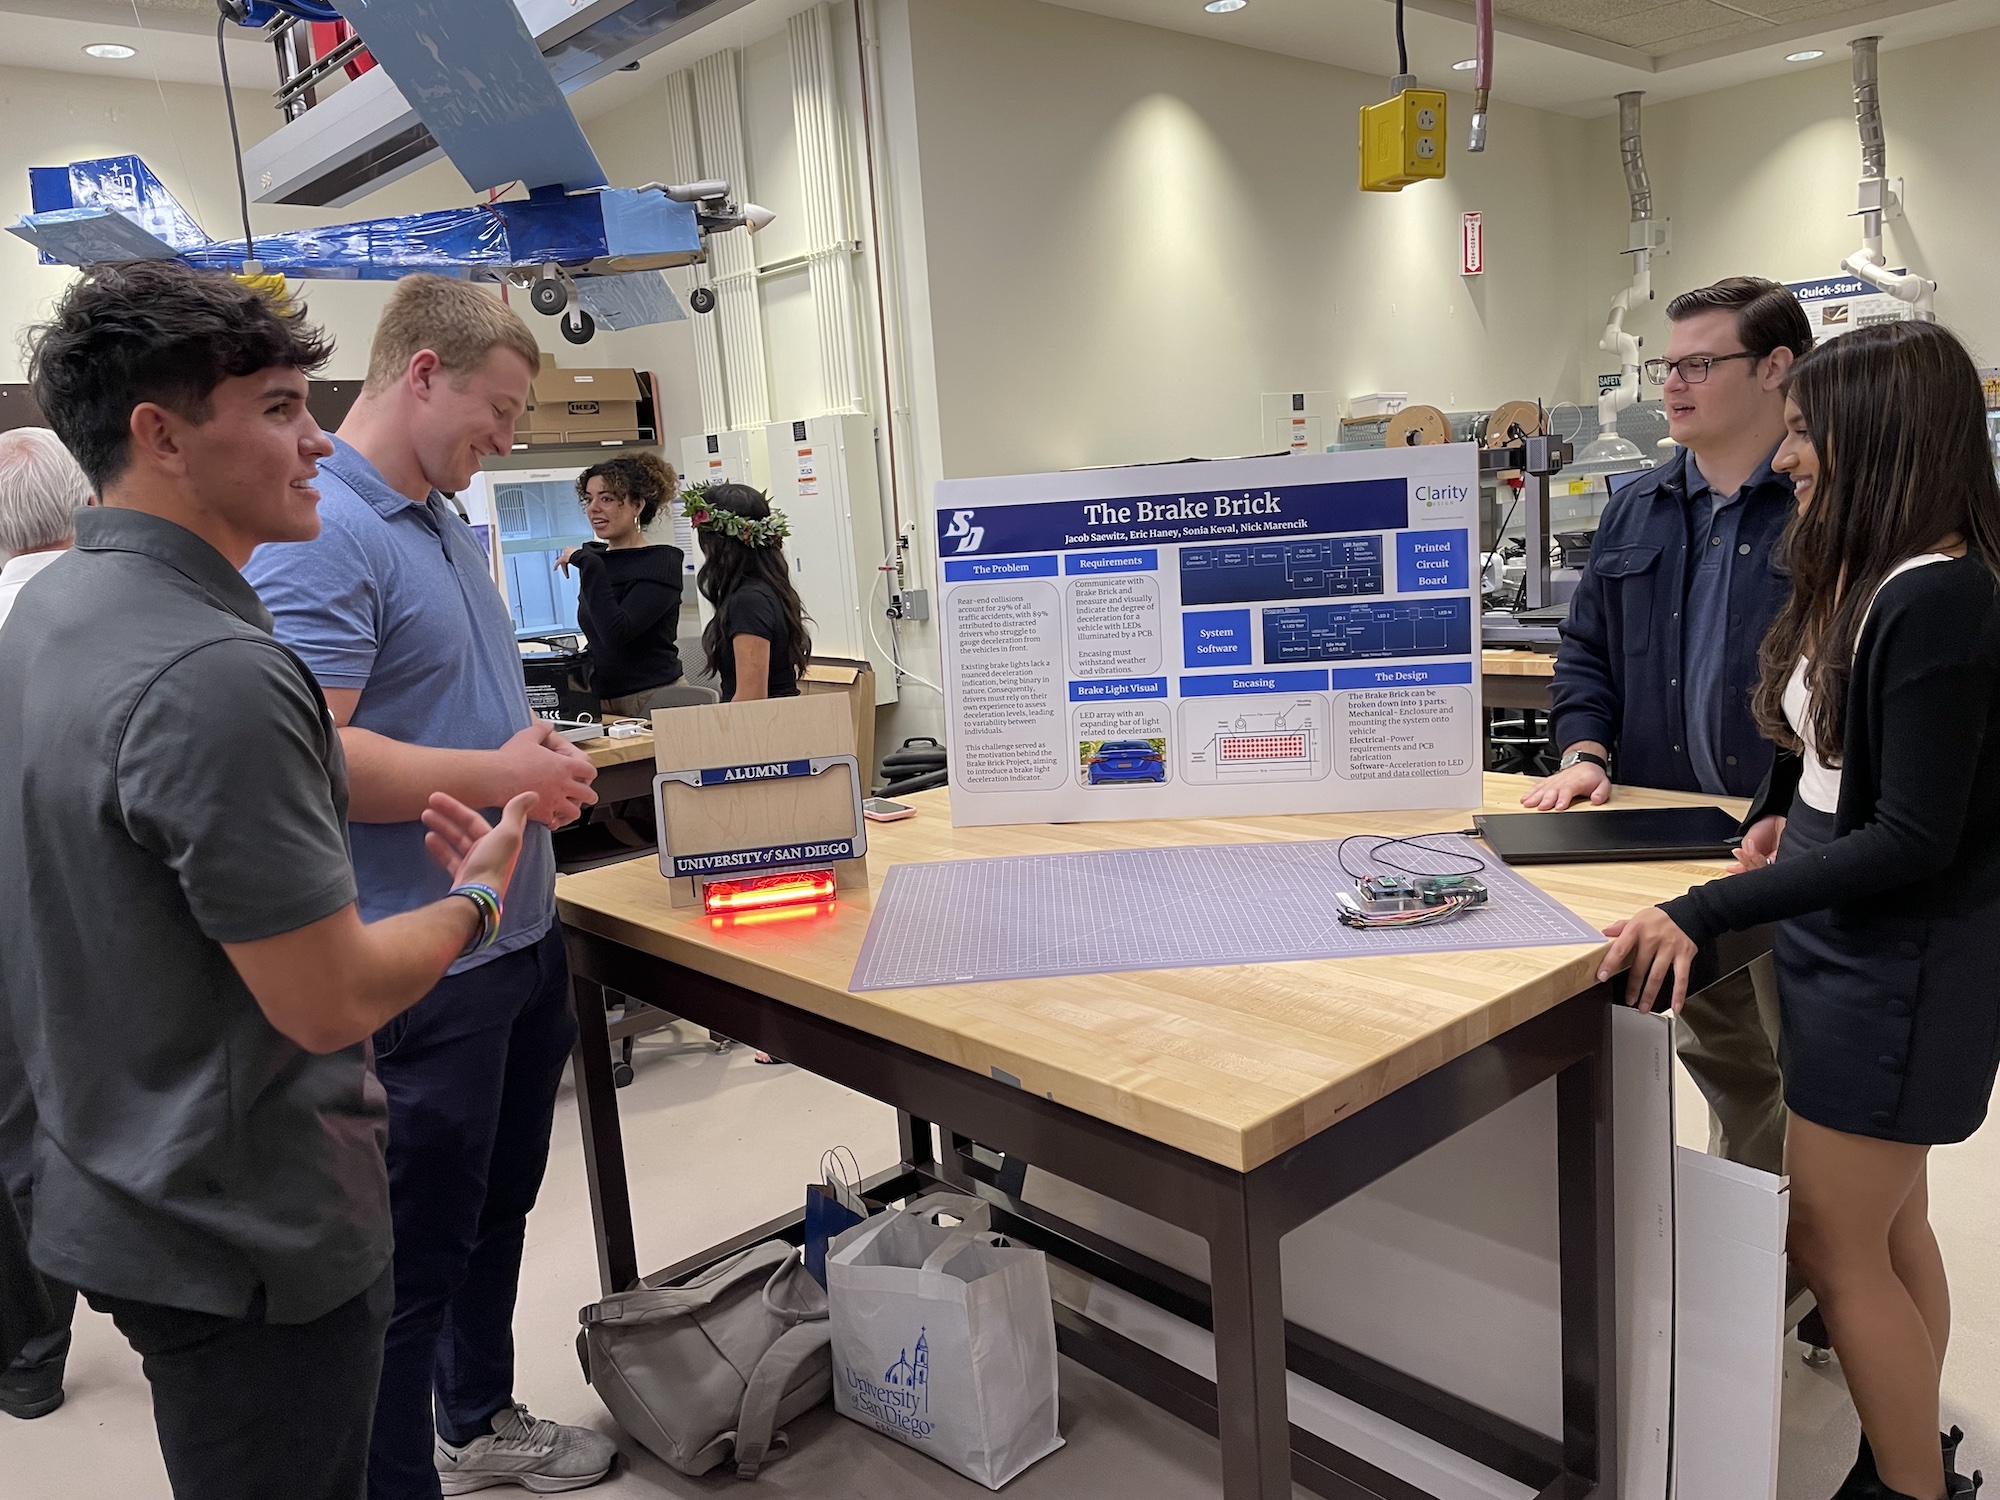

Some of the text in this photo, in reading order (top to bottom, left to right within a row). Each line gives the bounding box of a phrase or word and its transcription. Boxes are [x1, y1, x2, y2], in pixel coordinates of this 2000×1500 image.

[1800, 281, 1862, 299] Quick-Start
[1416, 485, 1468, 503] Clarity
[1084, 492, 1281, 525] The Brake Brick
[1064, 519, 1307, 544] Jacob Saewitz, Eric Haney, Sonia Keval, Nick Marencik
[1414, 542, 1450, 552] Printed
[973, 563, 1029, 574] The Problem
[1080, 557, 1142, 569] Requirements
[1416, 559, 1449, 569] Circuit
[1074, 576, 1144, 588] Communicate with
[1419, 575, 1447, 585] Board
[1075, 586, 1132, 596] Brake Brick and
[957, 594, 1023, 605] Rear-end collisions
[1108, 595, 1122, 603] and
[1123, 594, 1152, 603] visually
[957, 605, 984, 613] account
[985, 604, 995, 612] for
[997, 604, 1013, 612] 29%
[1013, 602, 1021, 610] of
[1076, 602, 1154, 614] indicate the degree of
[957, 609, 1048, 621] traffic accidents, with 89%
[1076, 613, 1121, 623] deceleration
[1123, 612, 1133, 620] for
[958, 618, 1036, 630] attributed to distracted
[1076, 621, 1141, 631] vehicle with LEDs
[958, 630, 983, 638] drivers
[999, 627, 1028, 636] struggle
[1077, 631, 1120, 640] illuminated
[1120, 630, 1130, 640] by
[1137, 629, 1153, 637] PCB.
[1200, 629, 1233, 639] System
[959, 635, 1040, 648] gauge deceleration from
[972, 645, 999, 653] vehicles
[1078, 648, 1131, 658] Encasing must
[1197, 644, 1237, 654] Software
[960, 662, 989, 671] Existing
[989, 661, 1009, 669] brake
[1009, 660, 1029, 669] lights
[1030, 659, 1044, 667] lack
[1078, 656, 1146, 666] withstand weather
[1078, 665, 1133, 675] and vibrations.
[1375, 670, 1427, 682] The Design
[1233, 678, 1275, 689] Encasing
[1078, 683, 1157, 696] Brake Light Visual
[1347, 692, 1363, 700] The
[1364, 690, 1387, 699] Brake
[1389, 689, 1409, 698] Brick
[1426, 688, 1436, 696] be
[1347, 697, 1446, 708] broken down into 3 parts:
[1079, 711, 1095, 719] LED
[1116, 709, 1133, 717] with
[1399, 707, 1437, 715] Enclosure
[1438, 705, 1453, 713] and
[1079, 716, 1159, 729] expanding bar of light
[1348, 715, 1449, 727] mounting the system onto
[1080, 728, 1105, 736] related
[1116, 726, 1163, 735] deceleration.
[1348, 726, 1376, 735] vehicle
[1349, 741, 1434, 754] requirements and PCB
[1349, 752, 1391, 761] fabrication
[1437, 758, 1446, 766] to
[1447, 758, 1463, 766] LED
[724, 763, 789, 781] ALUMNI
[1349, 768, 1449, 780] output and data collection
[677, 842, 850, 872] UNIVERSITY of SAN DIEGO
[846, 1366, 920, 1417] University
[851, 1392, 931, 1439] of San Diego
